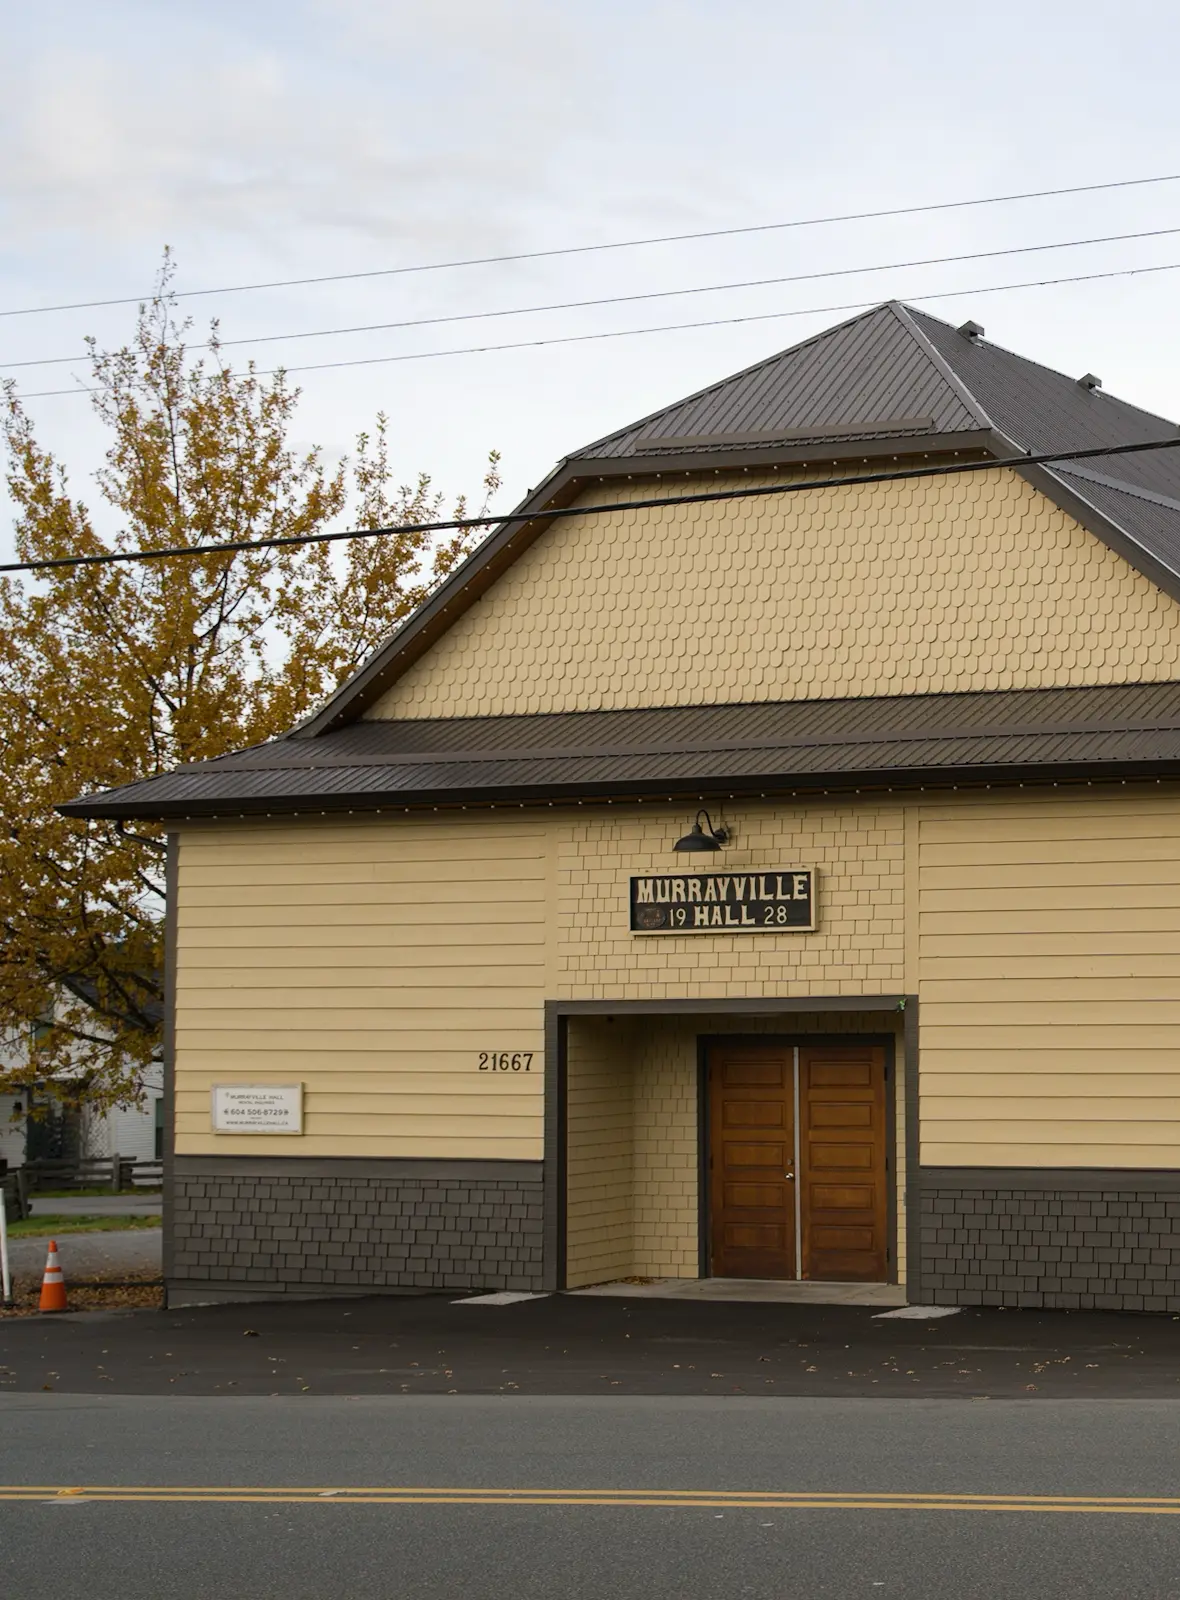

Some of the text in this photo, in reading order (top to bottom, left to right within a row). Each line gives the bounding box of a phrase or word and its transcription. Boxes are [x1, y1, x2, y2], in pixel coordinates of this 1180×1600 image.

[636, 875, 808, 903] MURRAYVILLE
[669, 908, 686, 926] 19
[694, 905, 755, 926] HALL
[764, 905, 788, 925] 28
[479, 1052, 534, 1071] 21667
